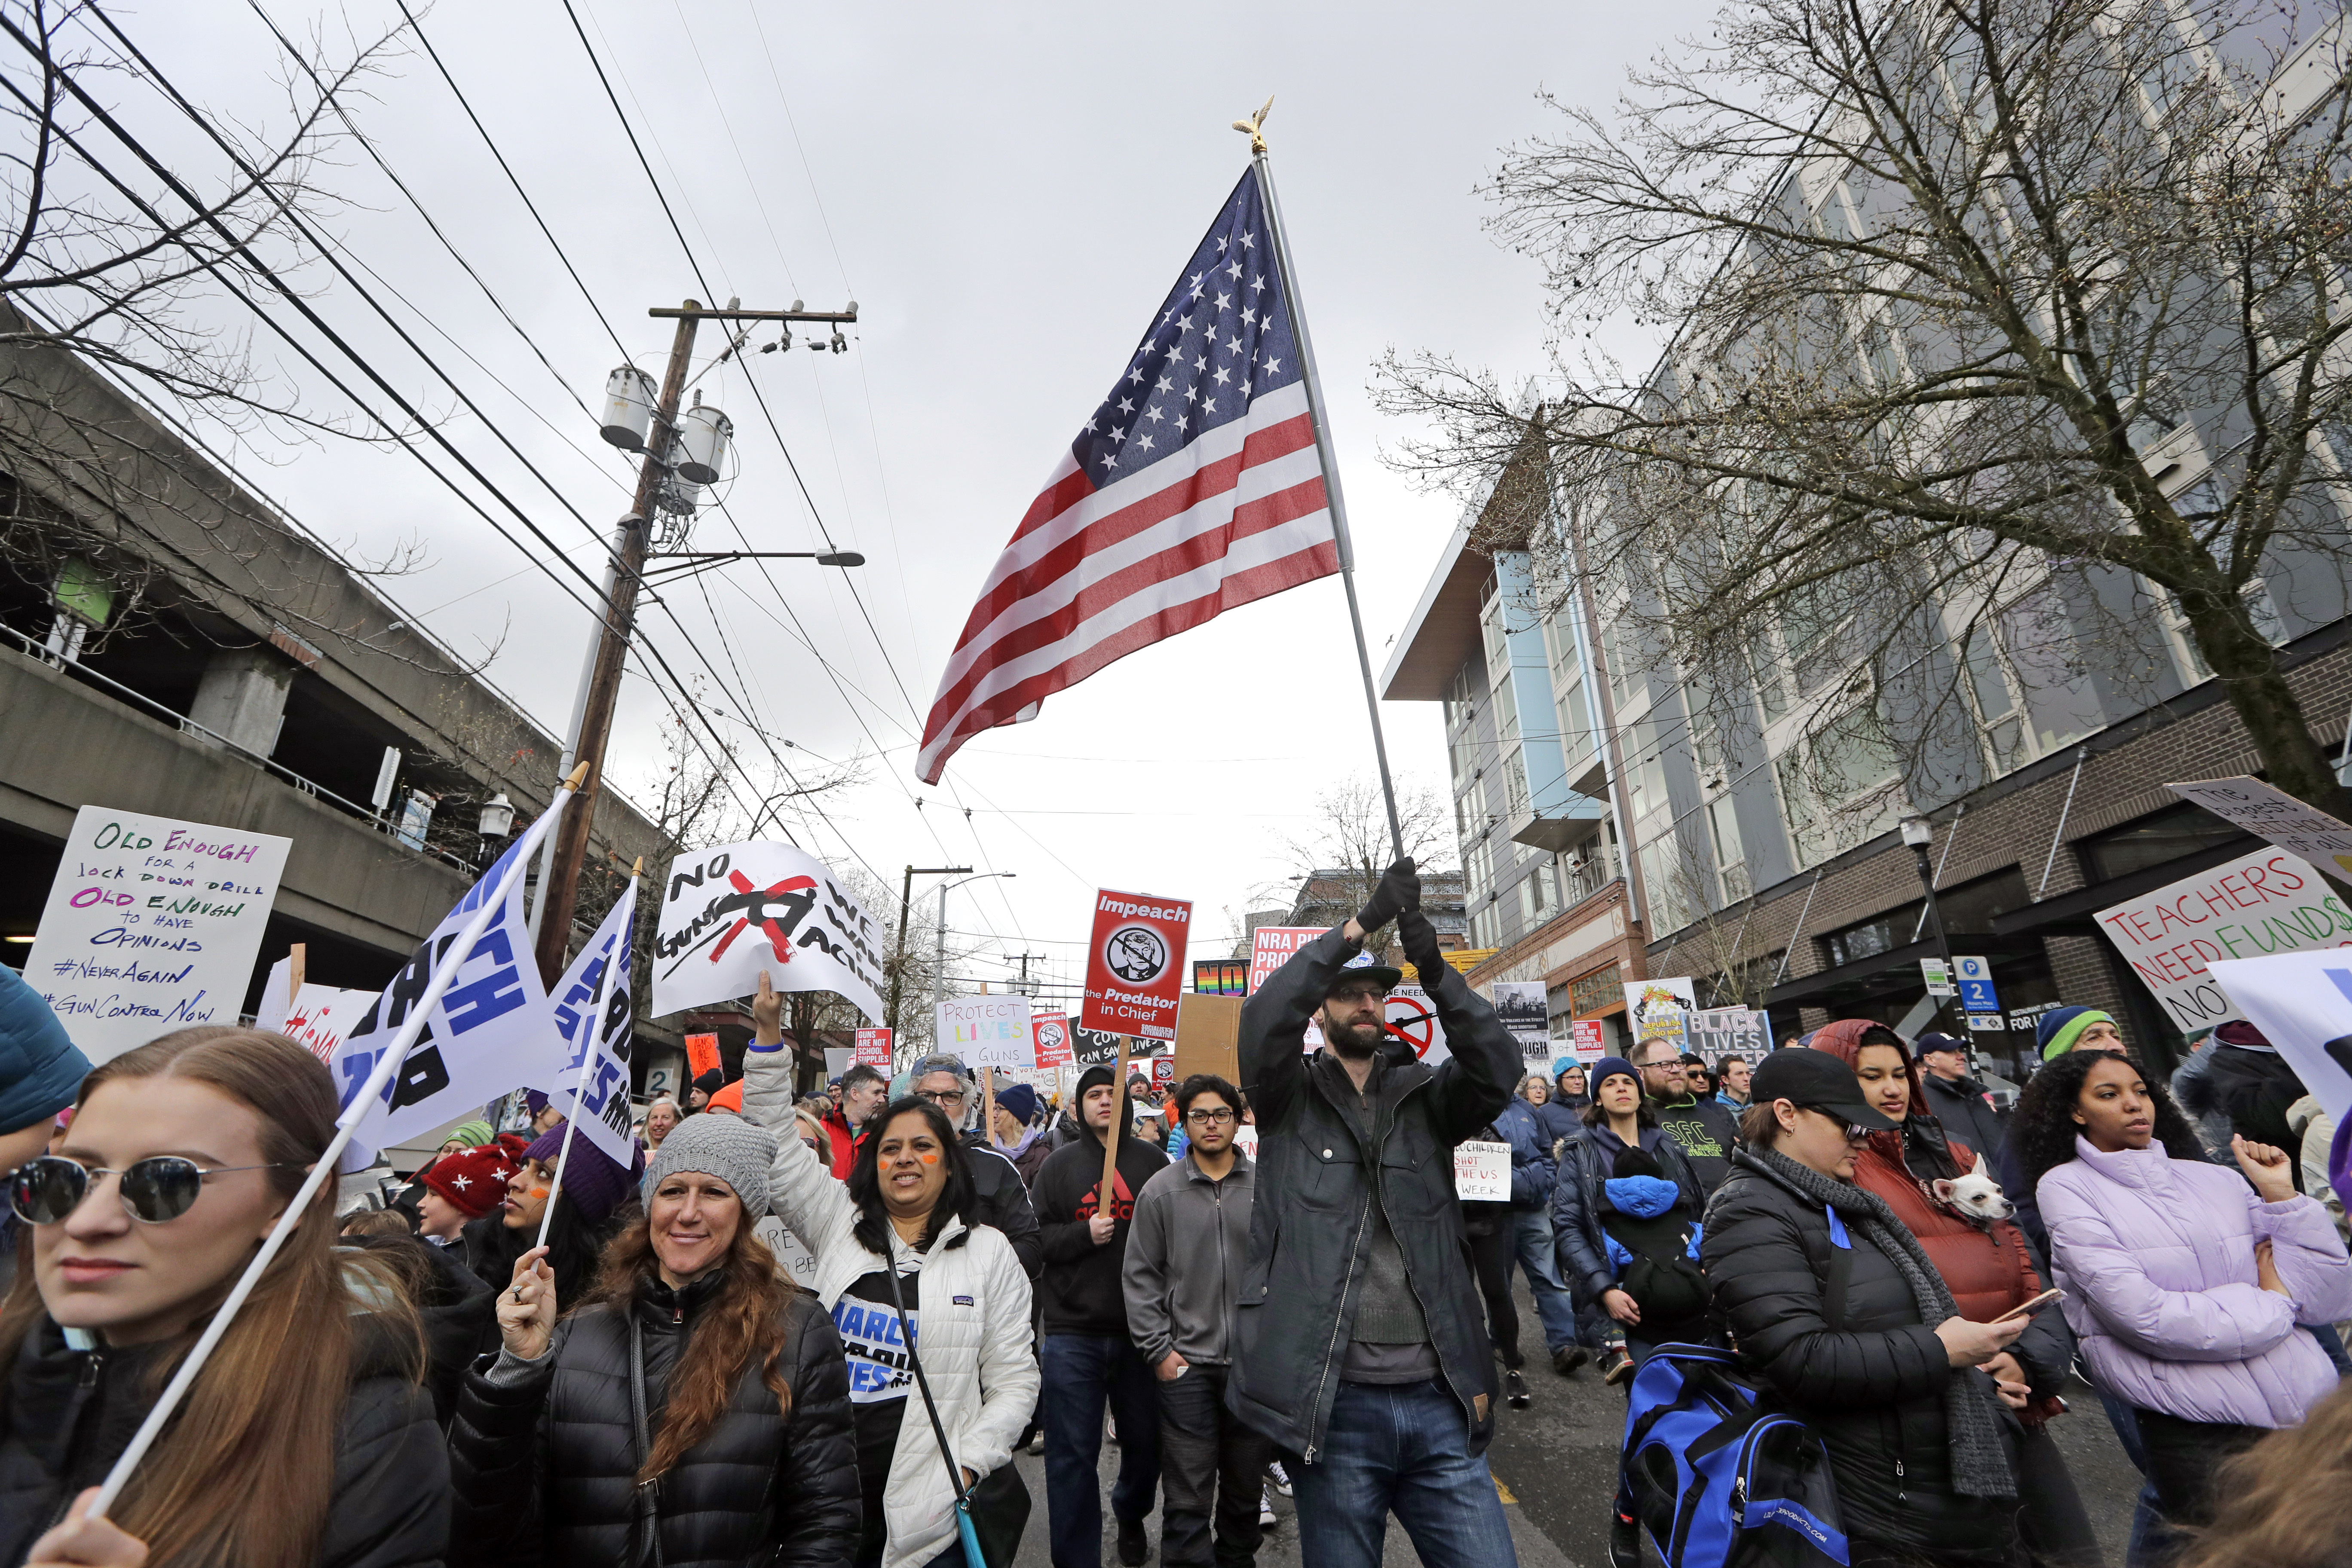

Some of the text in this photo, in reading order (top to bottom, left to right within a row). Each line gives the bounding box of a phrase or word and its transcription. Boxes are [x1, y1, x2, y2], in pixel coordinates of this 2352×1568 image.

[2188, 788, 2249, 802] The
[2205, 797, 2298, 819] biggest
[2287, 836, 2319, 851] of
[145, 856, 194, 871] FOR A
[138, 873, 194, 887] DOWN
[204, 881, 264, 895] DRILL
[669, 852, 731, 902] NO
[1098, 895, 1188, 922] Impeach
[2105, 857, 2304, 945] TEACHERS
[824, 877, 874, 945] WE
[153, 915, 193, 928] HAVE
[654, 895, 721, 960] GUNS
[1259, 932, 1291, 949] NRA
[2132, 939, 2222, 989] NEED
[1197, 962, 1250, 997] NO
[1086, 988, 1177, 1009] the Predator
[1971, 983, 1985, 999] 2
[1101, 1002, 1158, 1022] in Chief
[2009, 1005, 2041, 1017] RESTAURANT
[2045, 1001, 2063, 1010] RETAIL
[2165, 979, 2227, 1028] NO
[943, 1003, 1020, 1022] PROTECT
[1032, 1014, 1066, 1023] Impeach
[1141, 1024, 1170, 1032] SOCIALIST
[1643, 1020, 1682, 1029] REPUBLICA
[1689, 1013, 1761, 1033] BLACK
[2009, 1016, 2034, 1031] FOR
[955, 1021, 1023, 1043] LIVES
[1141, 1029, 1173, 1039] ALTERNATIVE
[1642, 1030, 1666, 1038] BLOOD
[1701, 1032, 1761, 1050] LIVES
[858, 1047, 884, 1055] SCHOOL
[858, 1055, 889, 1063] SUPPLIES
[979, 1047, 1020, 1062] GUNS
[1079, 1050, 1101, 1064] CAN
[1103, 1044, 1120, 1059] SAV
[1690, 1050, 1769, 1069] MAER
[650, 1071, 666, 1092] 2
[1661, 1121, 1716, 1145] SFC
[1467, 1143, 1510, 1154] CHILDREN
[1455, 1155, 1483, 1165] SHOT
[1455, 1168, 1477, 1179] THE
[1461, 1183, 1500, 1195] WEEK
